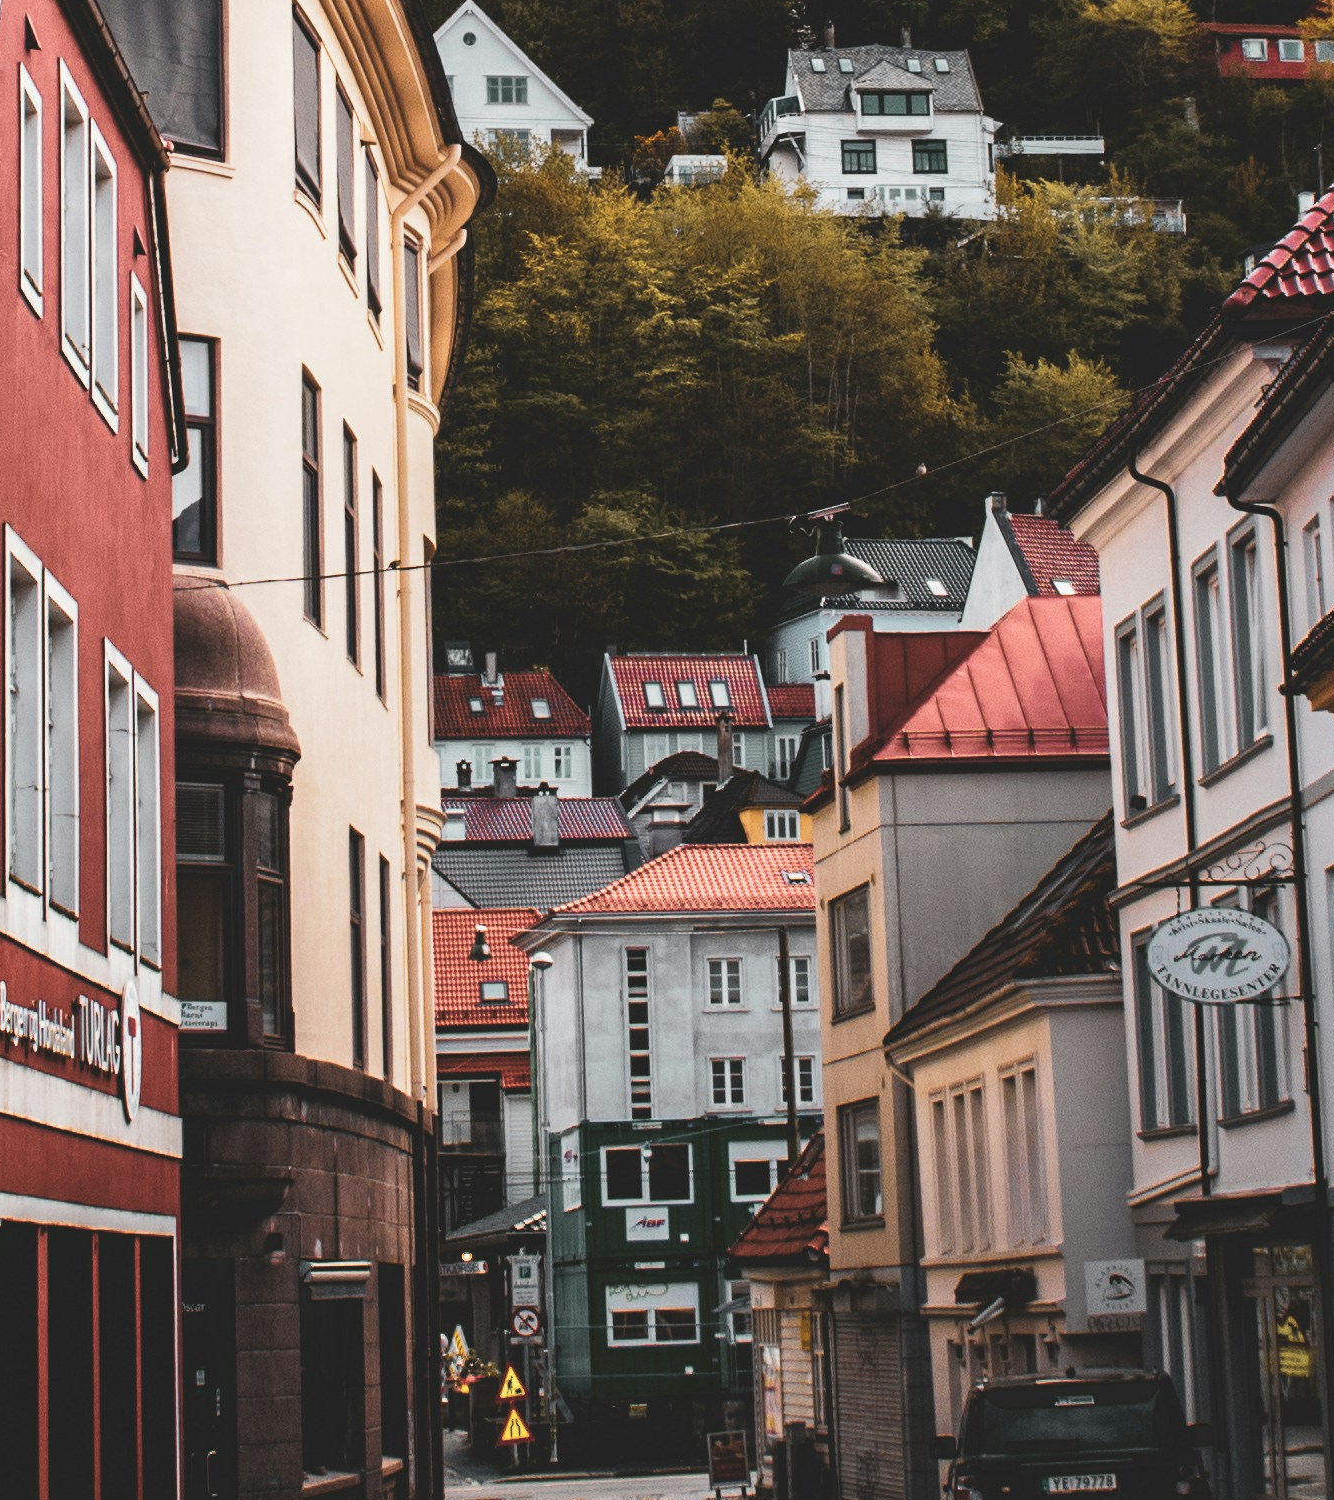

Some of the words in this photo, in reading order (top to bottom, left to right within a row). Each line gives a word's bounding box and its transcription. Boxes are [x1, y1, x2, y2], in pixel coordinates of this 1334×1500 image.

[1156, 963, 1281, 1000] TANNLEGESENTER
[79, 994, 121, 1075] TURLAG
[1075, 1474, 1114, 1489] 79778
